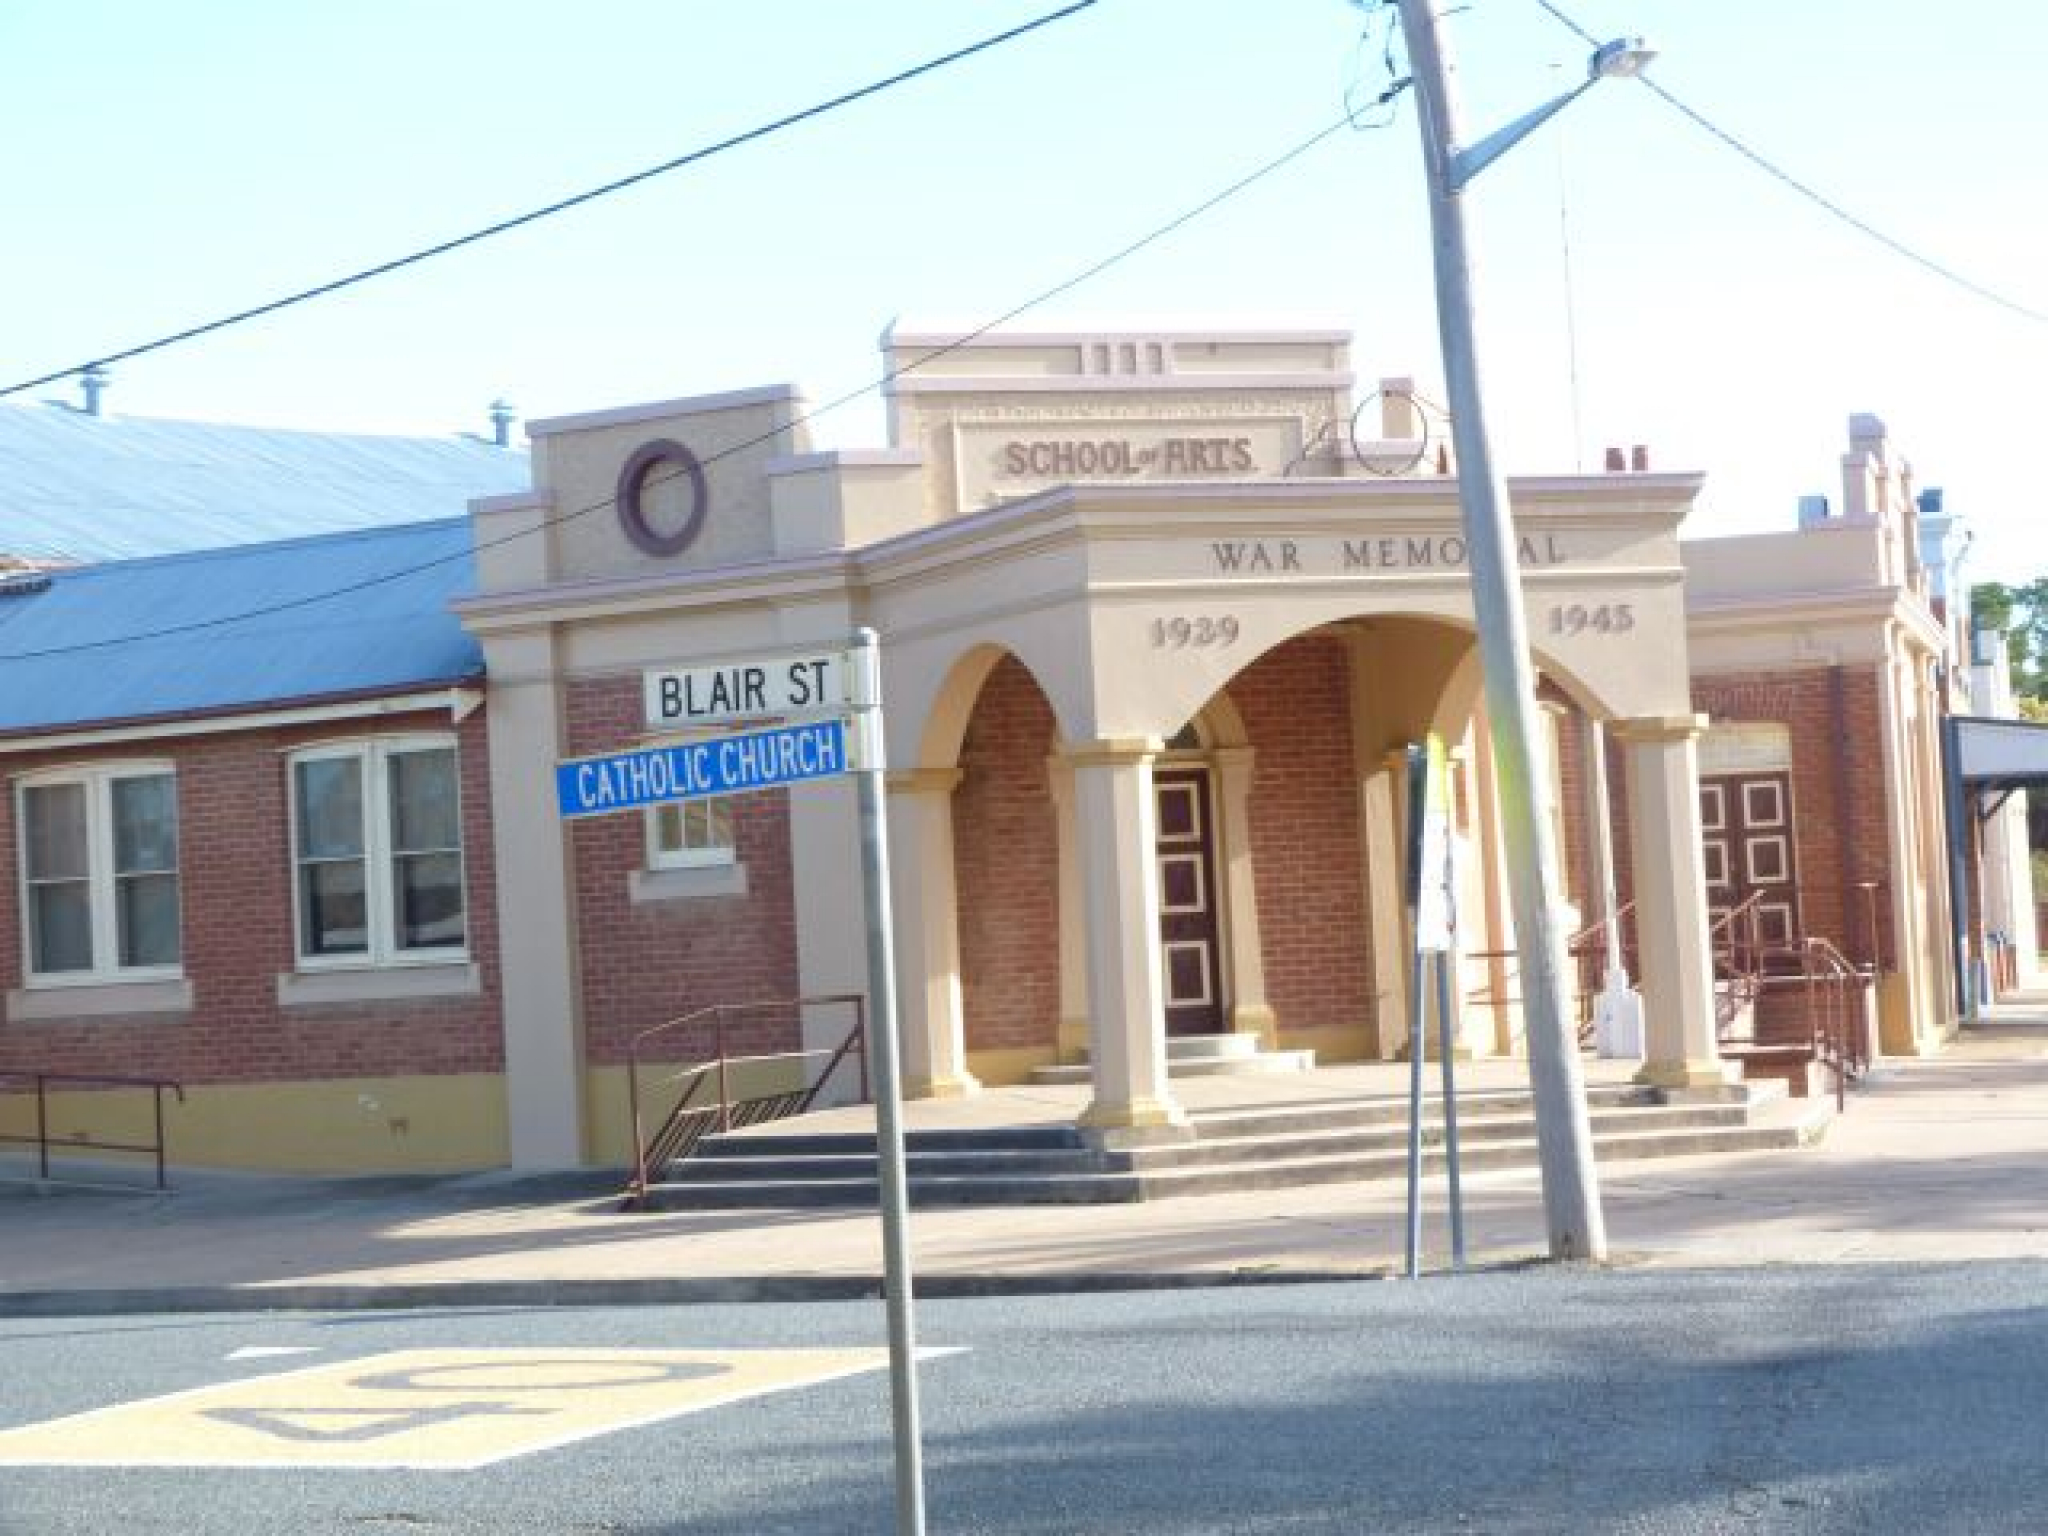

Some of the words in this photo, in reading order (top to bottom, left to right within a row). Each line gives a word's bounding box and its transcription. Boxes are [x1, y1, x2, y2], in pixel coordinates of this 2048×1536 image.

[1005, 440, 1139, 475] SCHOOL
[1212, 542, 1301, 571] WAR
[1342, 536, 1567, 569] MEMOAL
[1149, 616, 1240, 648] 1939
[1549, 604, 1635, 637] 1945
[659, 668, 766, 718] BLAIR
[788, 660, 830, 706] ST
[576, 744, 713, 808] CATHOLIC
[718, 727, 837, 785] CHURCH
